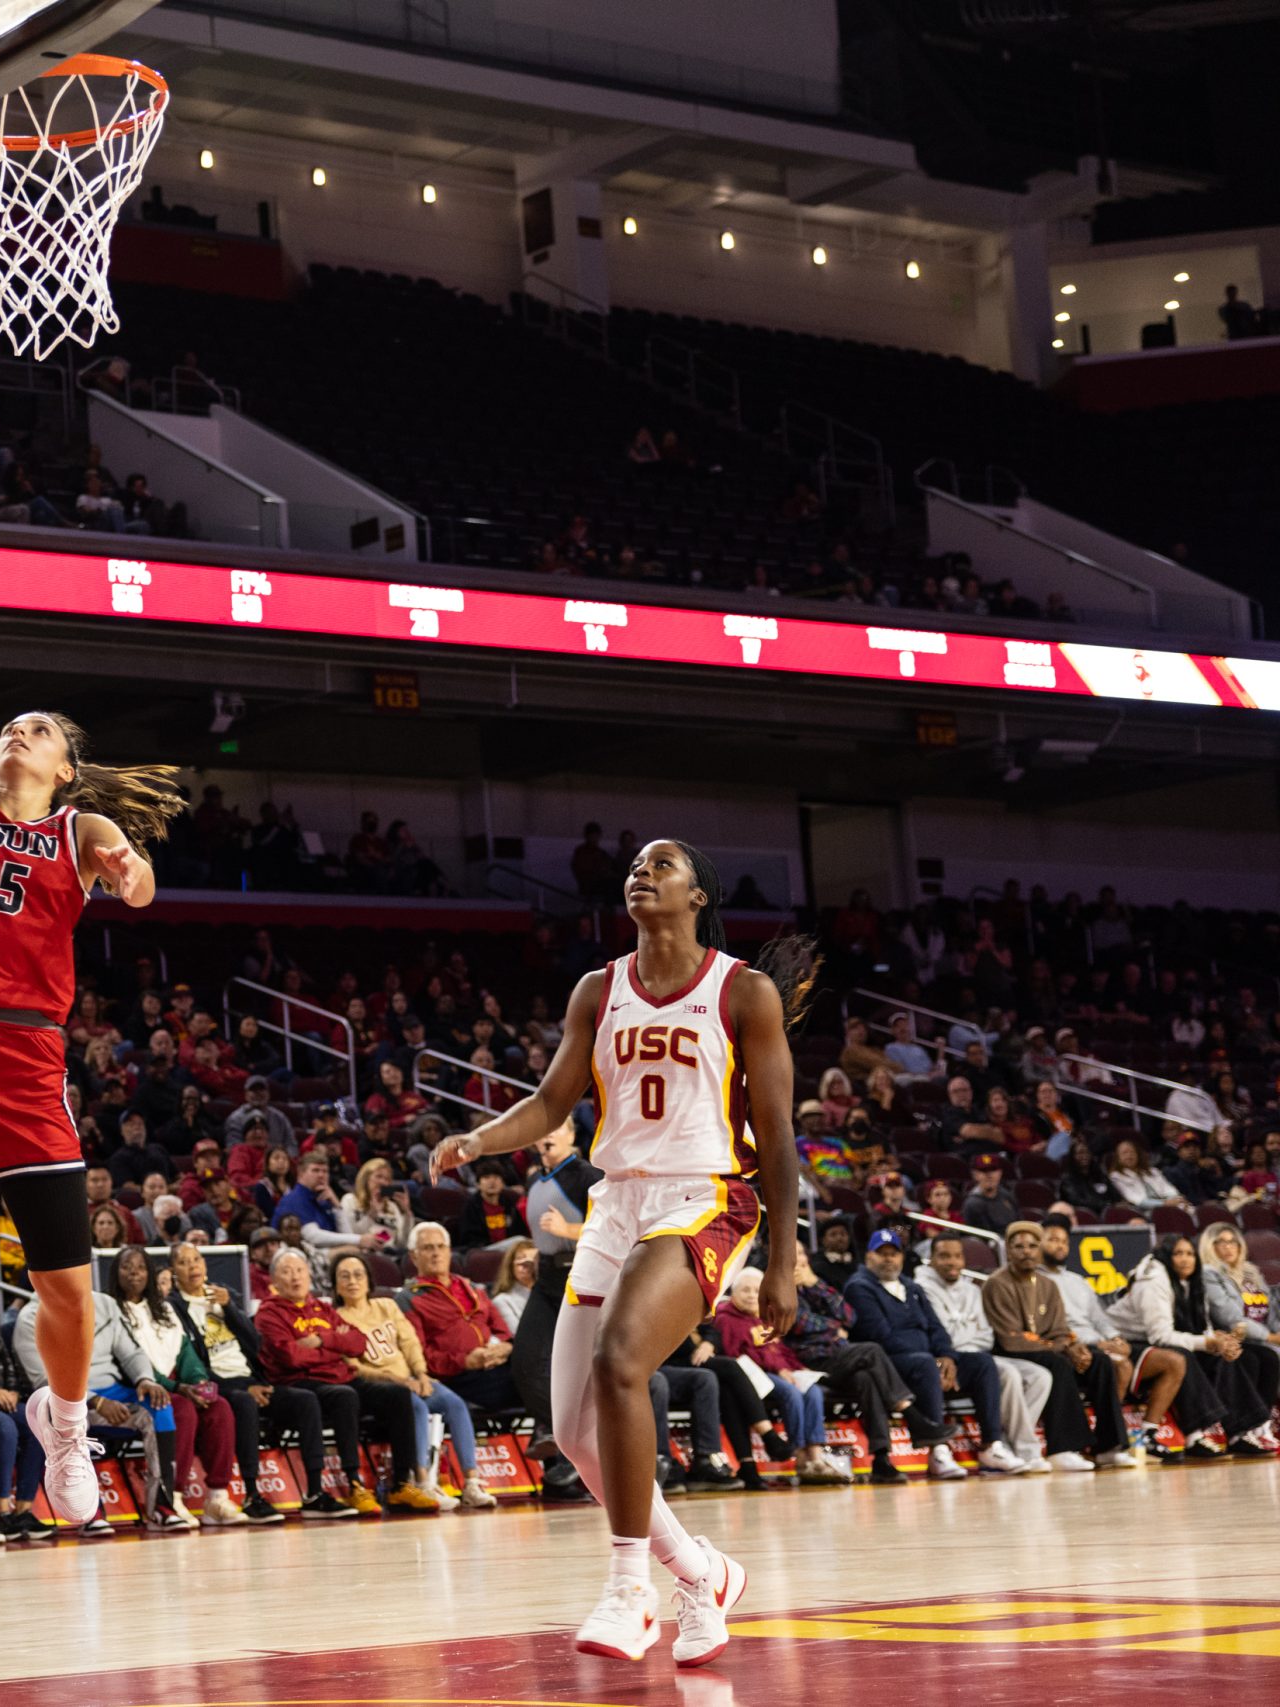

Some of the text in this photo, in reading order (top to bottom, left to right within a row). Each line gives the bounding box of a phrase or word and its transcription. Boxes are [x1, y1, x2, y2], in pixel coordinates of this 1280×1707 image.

[373, 687, 419, 709] 103
[614, 1026, 699, 1069] USC
[640, 1074, 665, 1121] 0
[475, 1444, 511, 1461] ELLS
[475, 1461, 518, 1479] ARGO
